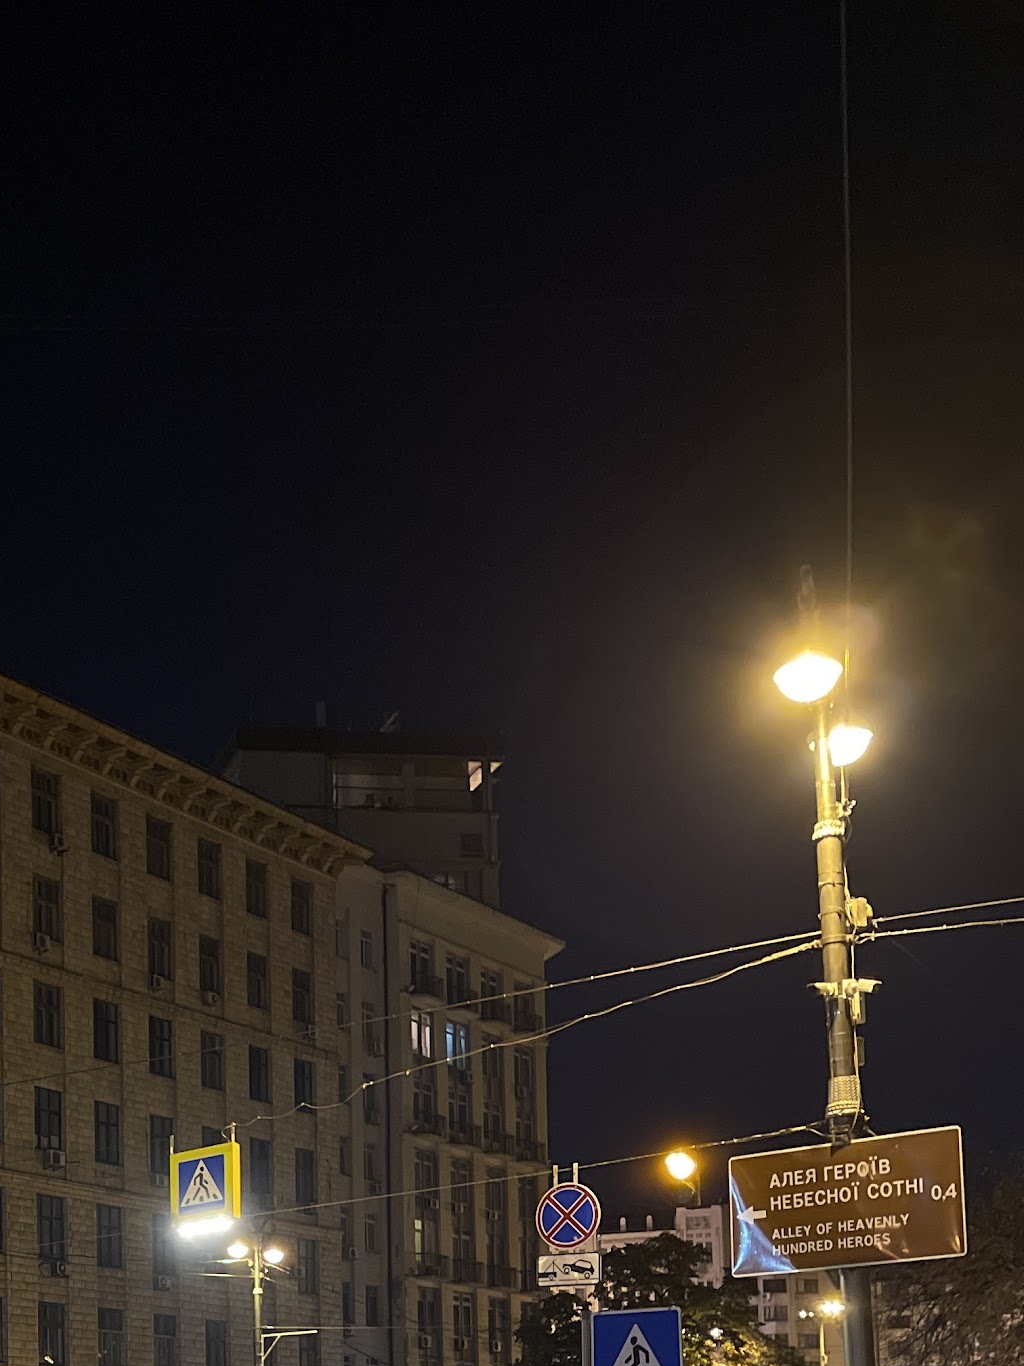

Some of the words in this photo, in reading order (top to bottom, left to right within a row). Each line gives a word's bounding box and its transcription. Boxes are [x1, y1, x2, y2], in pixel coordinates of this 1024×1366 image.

[769, 1168, 817, 1189] АЛЕЯ
[823, 1156, 891, 1182] ГЕРОЇВ
[770, 1181, 860, 1211] НЕБЕСНОЇ
[867, 1178, 924, 1200] СОТНІ
[930, 1183, 958, 1202] 0,4
[772, 1224, 812, 1240] ALLEY
[816, 1222, 833, 1235] OF
[837, 1213, 910, 1233] HEAVENLY
[772, 1239, 833, 1256] HUNDRED
[837, 1233, 891, 1250] HEROES
